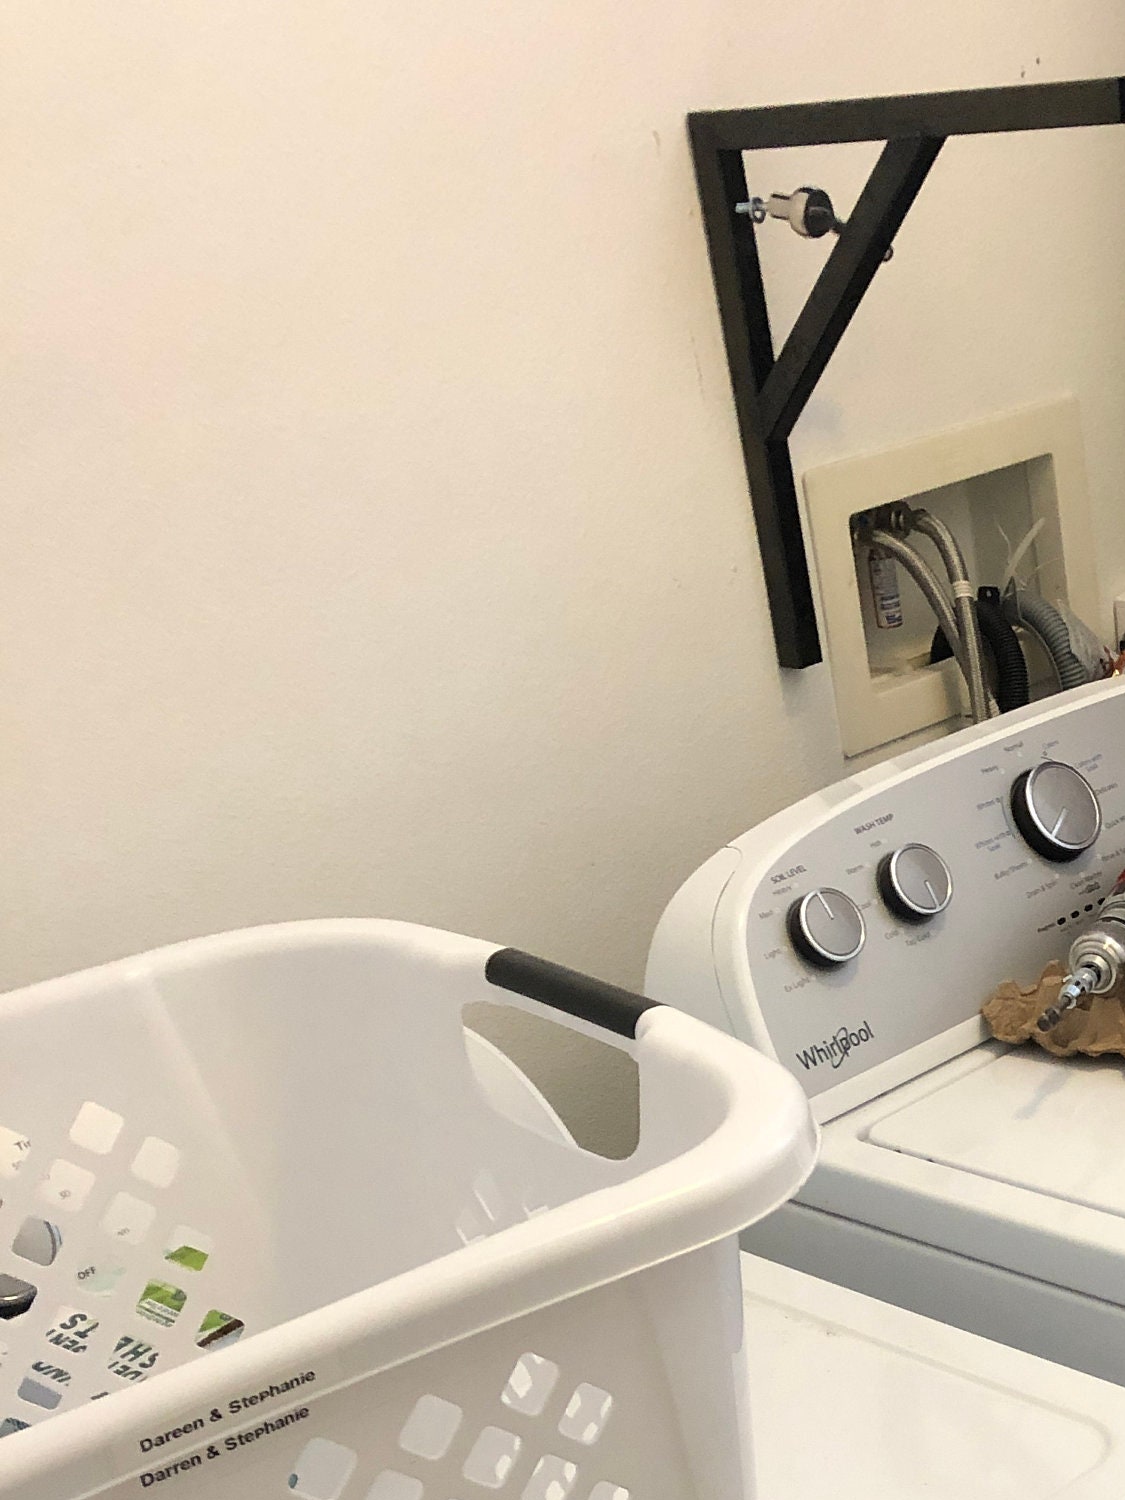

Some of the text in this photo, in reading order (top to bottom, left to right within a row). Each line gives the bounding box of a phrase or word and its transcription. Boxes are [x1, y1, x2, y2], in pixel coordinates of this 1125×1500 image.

[853, 813, 894, 835] WASH TEMP
[770, 864, 807, 884] SOIL LEVEL
[795, 1020, 875, 1070] Whirlpool
[77, 1266, 96, 1280] OFF
[139, 1370, 316, 1453] Dareen & Stephanie
[139, 1406, 310, 1488] Darren & Stephanie
